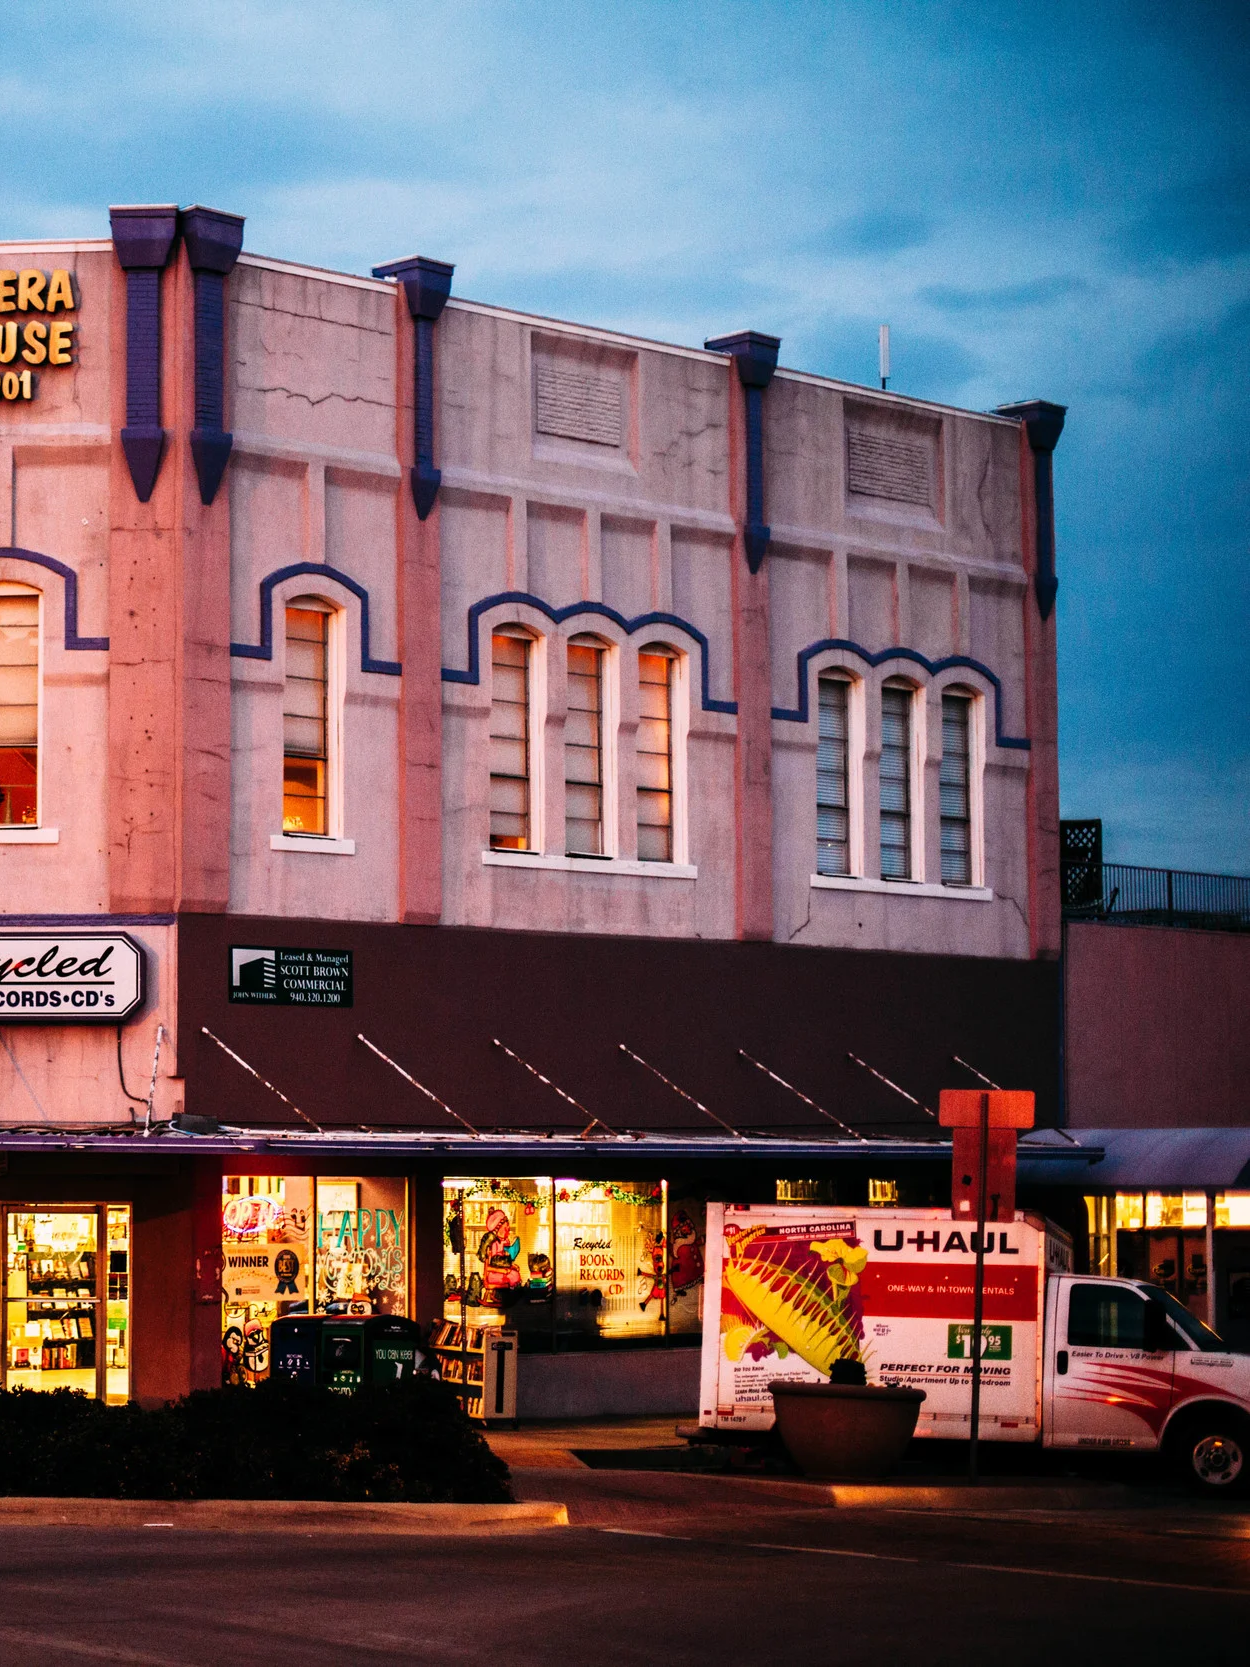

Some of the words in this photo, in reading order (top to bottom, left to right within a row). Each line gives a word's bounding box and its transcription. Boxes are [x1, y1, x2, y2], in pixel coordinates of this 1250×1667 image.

[280, 952, 305, 961] Leased
[306, 954, 313, 962] &
[315, 954, 349, 966] Managed
[280, 965, 311, 977] SCOTT
[313, 966, 349, 977] BROWN
[283, 978, 346, 991] COMMERCIAL
[233, 991, 249, 999] JOHN
[250, 991, 277, 1000] WITHERS
[290, 991, 341, 1003] 940.320.1200
[225, 1201, 274, 1229] OPEN
[317, 1208, 405, 1248] HAPPY
[779, 1226, 806, 1234] NORTH
[809, 1223, 851, 1233] CAROLINA
[573, 1237, 613, 1252] Recycled
[874, 1229, 1020, 1254] U-HAUL
[228, 1255, 269, 1268] WINNER
[277, 1259, 295, 1273] BEST
[580, 1254, 615, 1267] BOOKS
[580, 1268, 625, 1281] RECORDS
[887, 1284, 926, 1293] ONE-WAY
[927, 1285, 934, 1293] &
[936, 1286, 974, 1295] IN-TOWN
[982, 1287, 1015, 1295] ENTALS
[375, 1349, 387, 1360] YOU
[1071, 1350, 1093, 1358] Easier
[1141, 1353, 1164, 1361] Power
[879, 1363, 934, 1373] PERFECT
[936, 1365, 960, 1373] FOR
[963, 1366, 1011, 1375] MVING
[879, 1375, 947, 1385] Studio/Apartment
[949, 1377, 959, 1385] Up
[735, 1394, 774, 1402] uhaul.co
